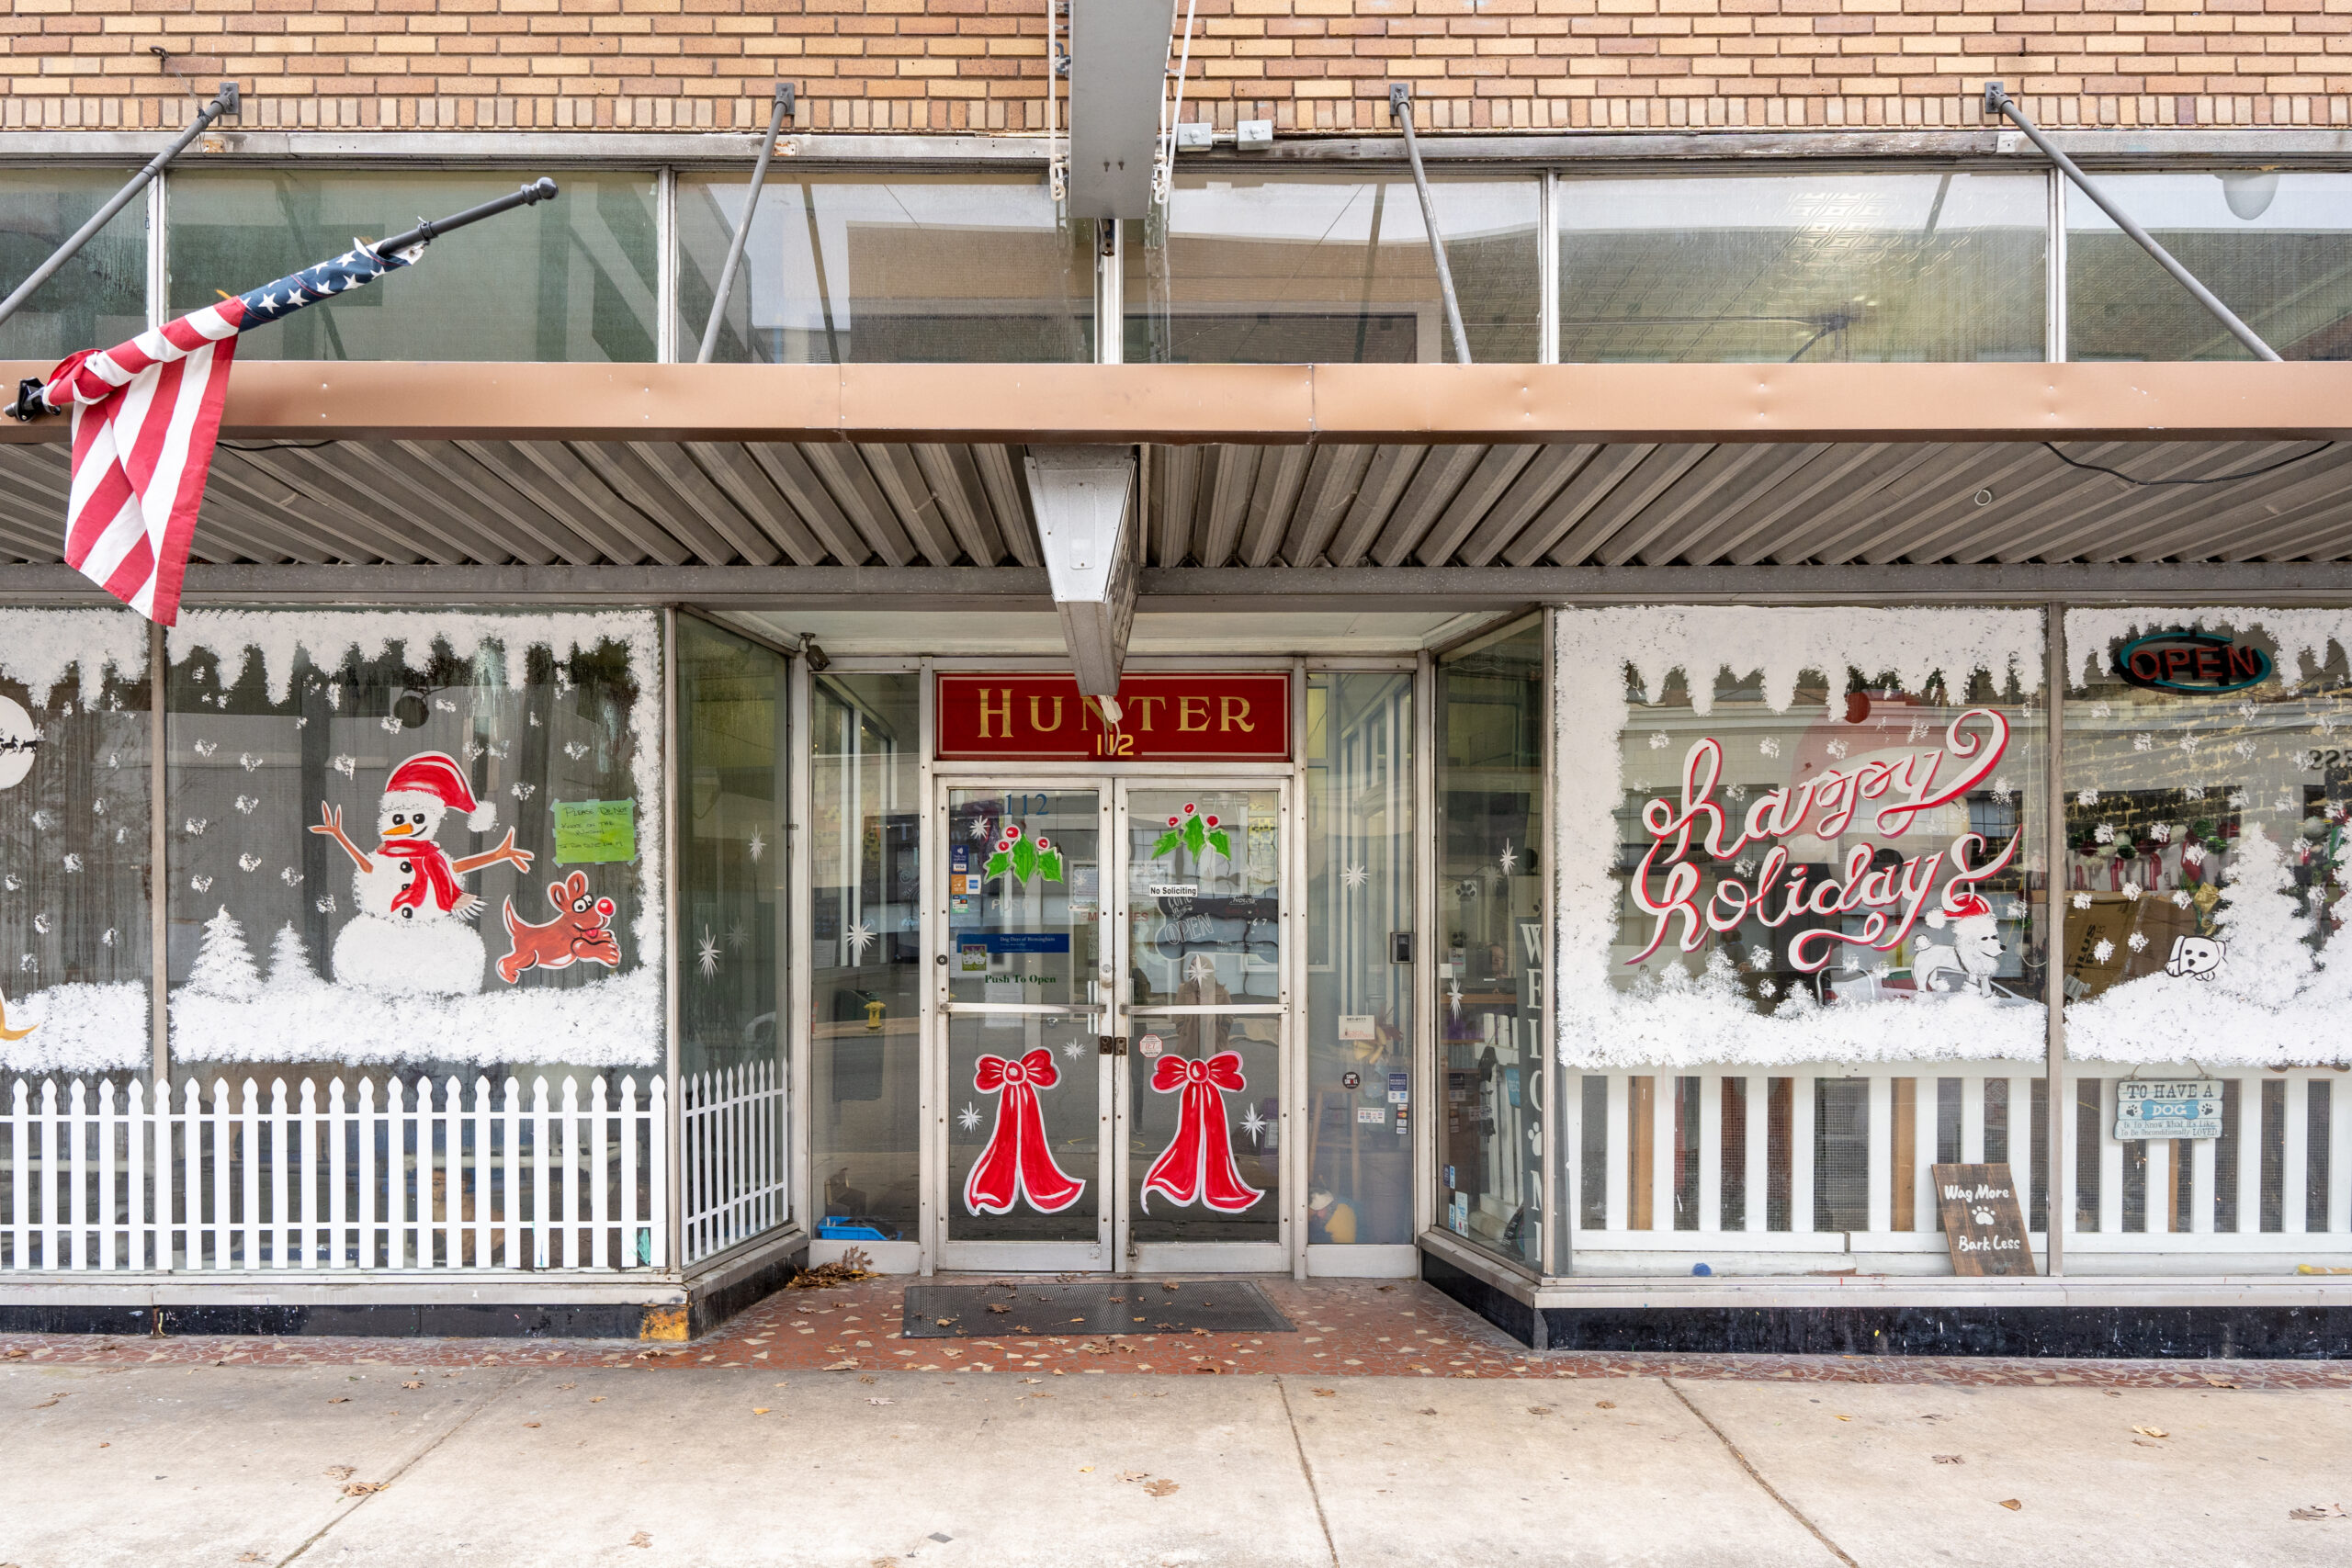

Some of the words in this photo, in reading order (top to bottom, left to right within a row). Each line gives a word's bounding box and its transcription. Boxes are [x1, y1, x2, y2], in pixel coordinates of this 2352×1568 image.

[2130, 645, 2256, 681] OPEN
[977, 688, 1255, 739] HUNTER
[1097, 733, 1135, 756] 112
[1005, 793, 1050, 816] 112
[1162, 886, 1197, 897] Soliciting
[1164, 912, 1215, 945] OPEN
[985, 975, 1010, 984] Push
[1013, 975, 1027, 984] To
[1029, 975, 1057, 986] Open
[2127, 1084, 2147, 1099] TO
[2154, 1084, 2197, 1099] HAVE
[2203, 1084, 2213, 1098] A
[2152, 1104, 2187, 1116] DOG
[1944, 1184, 1973, 1202] Wag
[1974, 1184, 2009, 1200] More
[1958, 1235, 1991, 1252] Bark
[1993, 1235, 2020, 1250] Less
